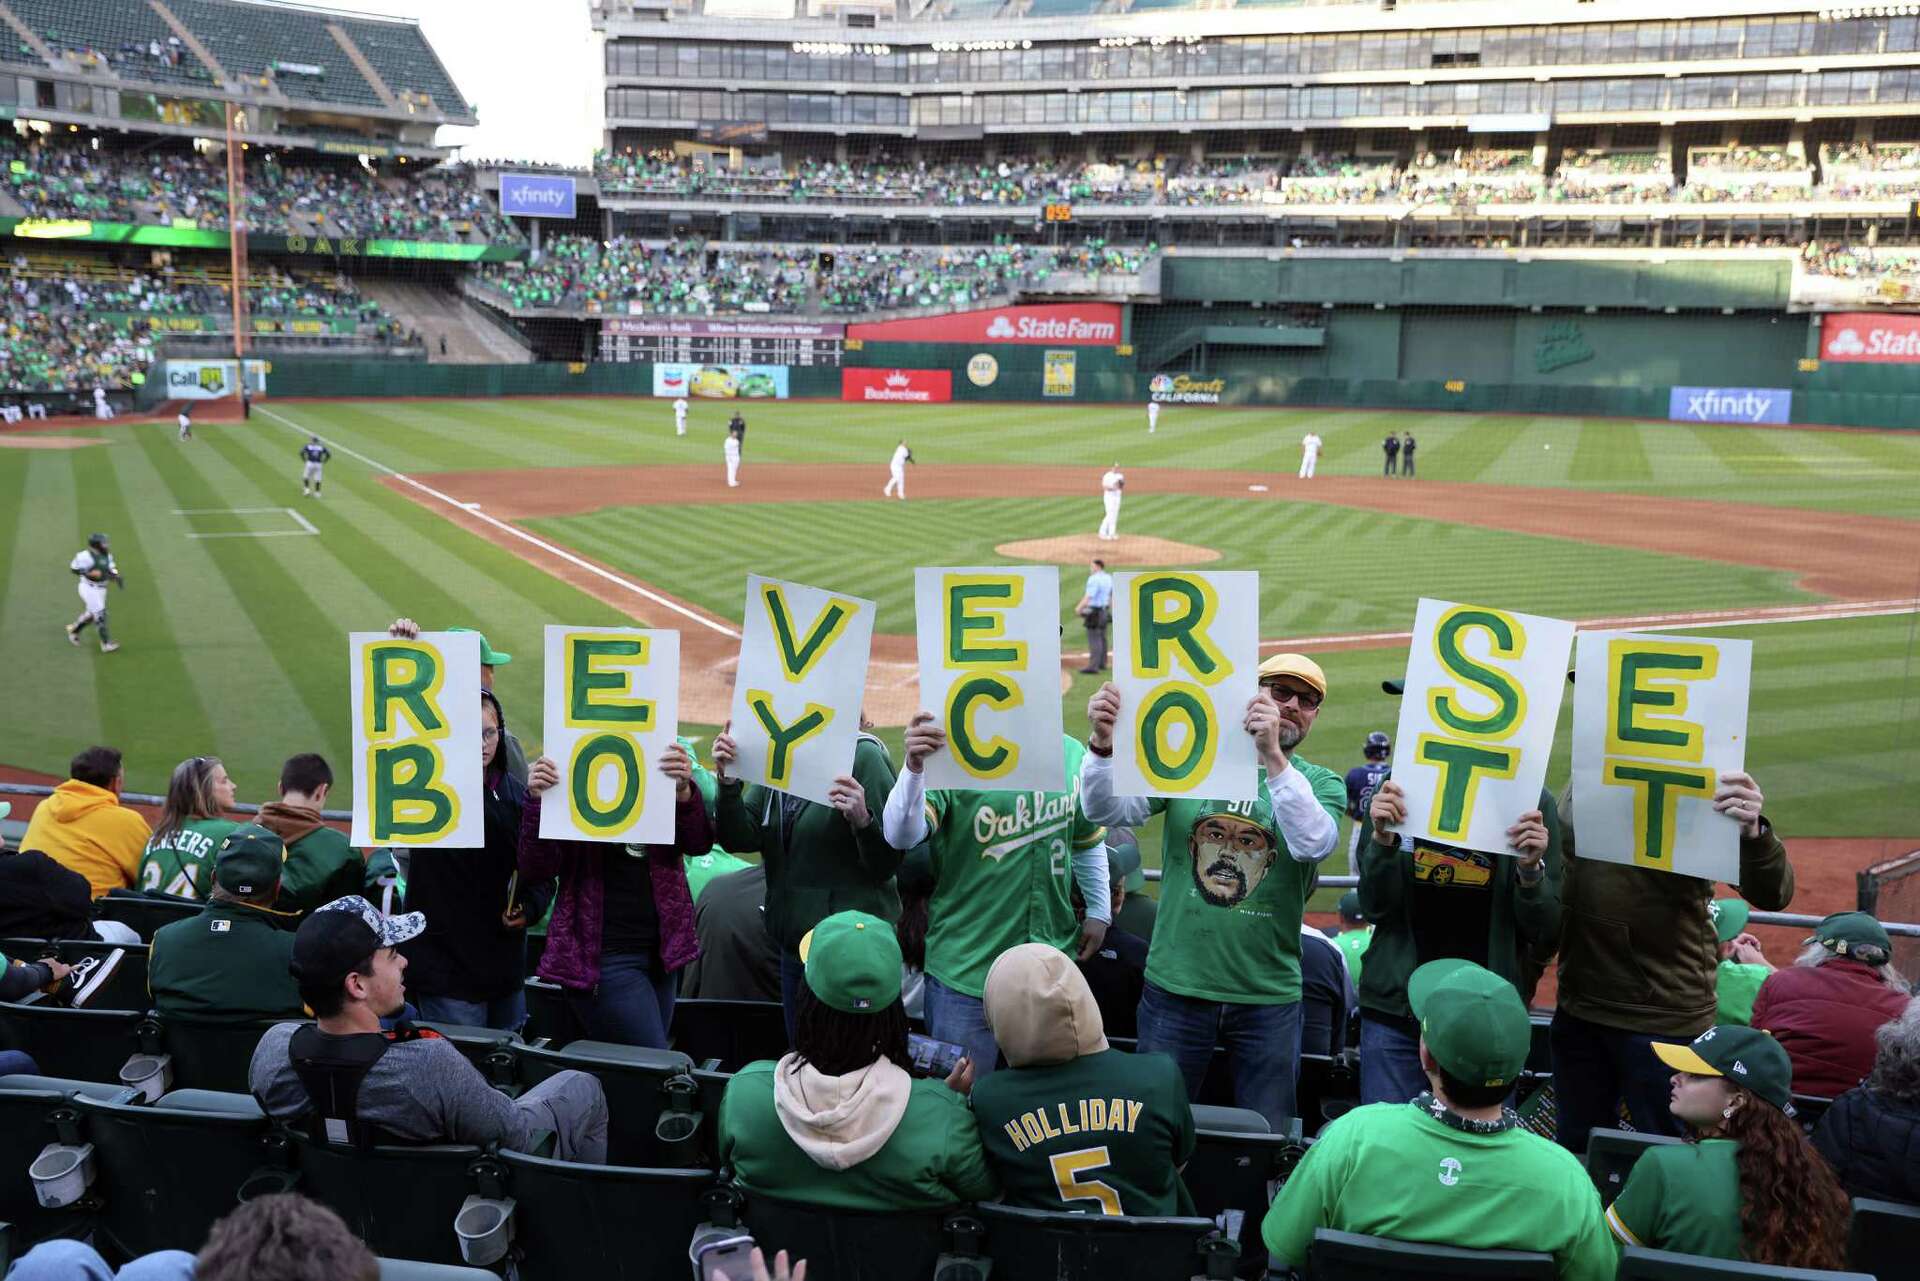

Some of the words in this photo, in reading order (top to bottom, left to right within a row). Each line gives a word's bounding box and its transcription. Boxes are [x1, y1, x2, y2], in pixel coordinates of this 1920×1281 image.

[510, 186, 565, 208] xfinity
[1864, 328, 1920, 355] Stat
[170, 372, 197, 386] Call
[1151, 392, 1219, 403] CALIFORNIA
[1687, 390, 1771, 422] xfinity
[974, 775, 1080, 843] Oakland
[1004, 1098, 1143, 1152] HOLLIDAY
[1049, 1146, 1124, 1217] 5
